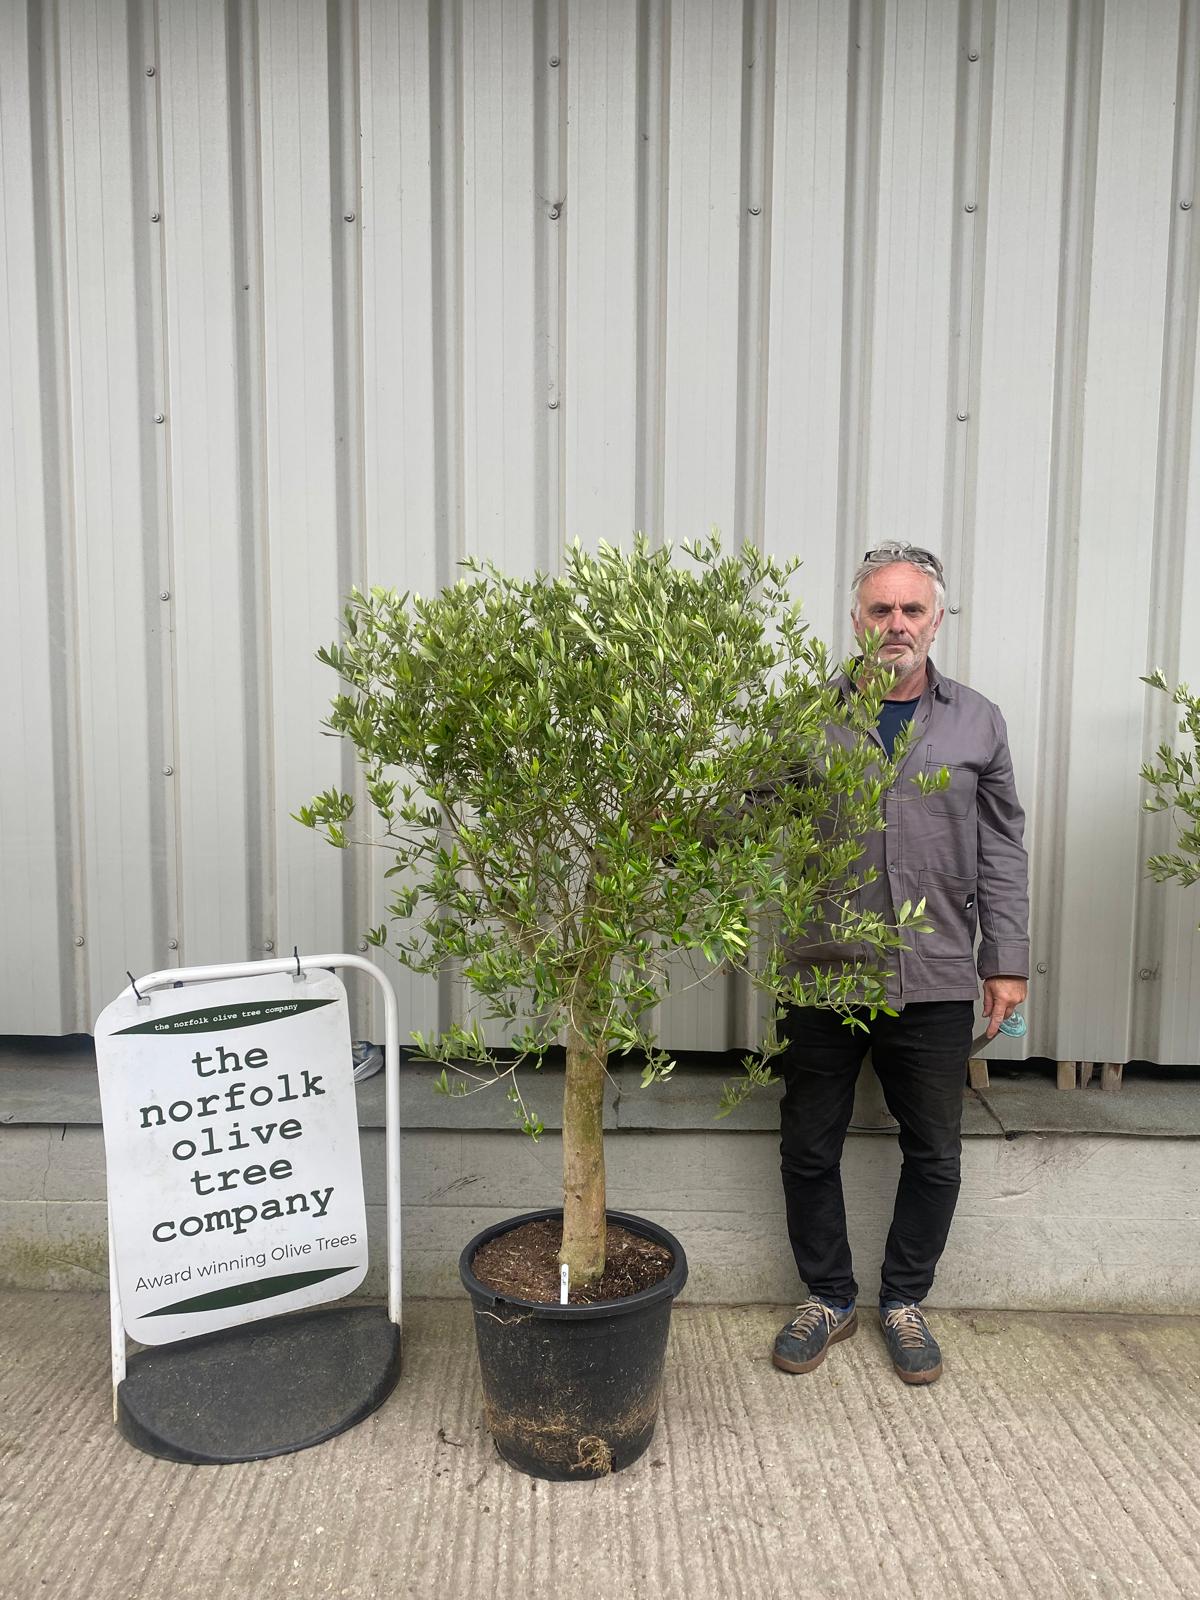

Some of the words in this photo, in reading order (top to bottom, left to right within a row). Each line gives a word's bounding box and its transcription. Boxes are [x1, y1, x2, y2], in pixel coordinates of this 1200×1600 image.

[154, 1023, 170, 1031] the
[174, 1017, 208, 1027] norfolk
[212, 1013, 237, 1022] olive
[242, 1009, 261, 1017] tree
[264, 1003, 298, 1013] company
[192, 1046, 269, 1077] the
[140, 1070, 326, 1128] norfolk
[172, 1118, 303, 1160] olive
[190, 1159, 293, 1195] tree
[152, 1186, 335, 1242] company
[135, 1266, 192, 1292] Award
[197, 1253, 266, 1277] winning
[271, 1243, 312, 1261] Olive
[315, 1233, 357, 1251] Trees
